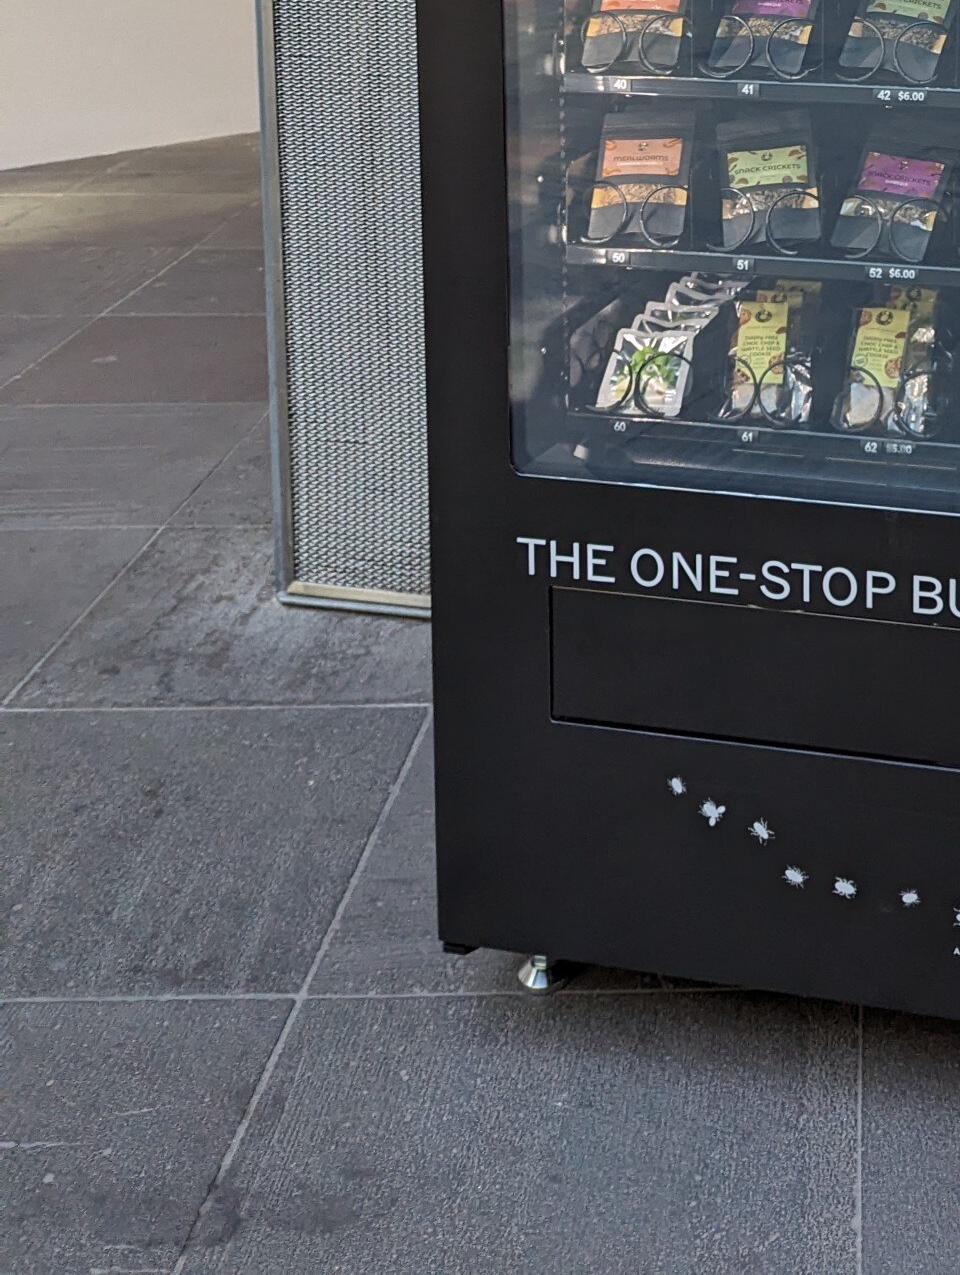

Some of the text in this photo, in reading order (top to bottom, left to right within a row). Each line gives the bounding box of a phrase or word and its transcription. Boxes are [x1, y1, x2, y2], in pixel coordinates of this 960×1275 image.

[613, 79, 627, 89] 40
[741, 84, 754, 95] 41
[877, 90, 925, 101] 42 $6.00
[734, 163, 801, 175] SNACK CRICKETS
[612, 252, 625, 263] 50
[736, 259, 749, 271] 51
[869, 268, 916, 279] 52 $6.00
[614, 421, 626, 432] 60
[741, 432, 753, 443] 61
[864, 442, 877, 453] 62
[516, 536, 616, 583] THE
[630, 547, 896, 609] ONE-STOP
[953, 947, 960, 955] A
